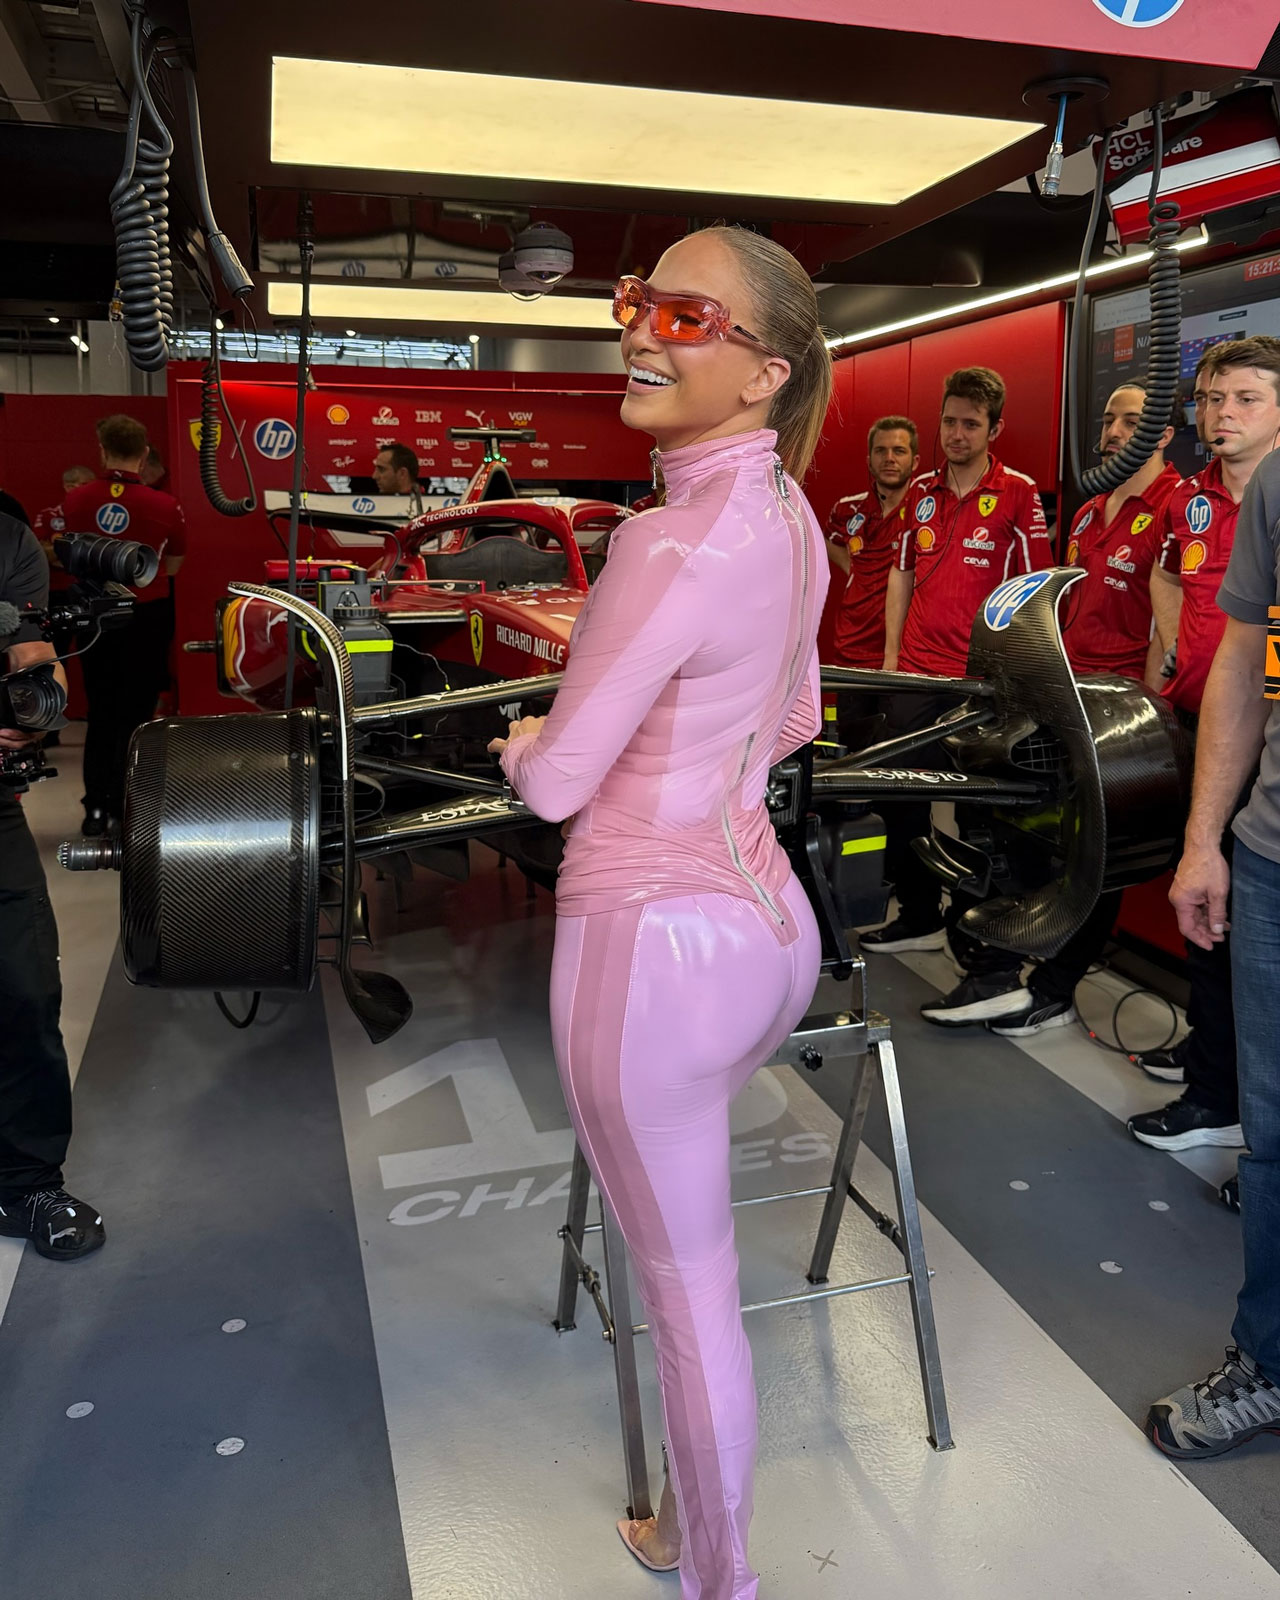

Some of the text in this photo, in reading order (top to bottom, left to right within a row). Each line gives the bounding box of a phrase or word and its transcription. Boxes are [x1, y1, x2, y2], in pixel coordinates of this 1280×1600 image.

[1108, 136, 1203, 170] Softare
[415, 410, 442, 423] IBM
[508, 412, 533, 421] VGW
[258, 420, 294, 459] hp
[100, 504, 127, 533] hp
[353, 498, 375, 513] hp
[426, 506, 479, 522] TECHNOLOGY
[916, 496, 936, 521] hp
[1188, 496, 1210, 532] hp
[496, 624, 566, 665] RICHARD MILLE
